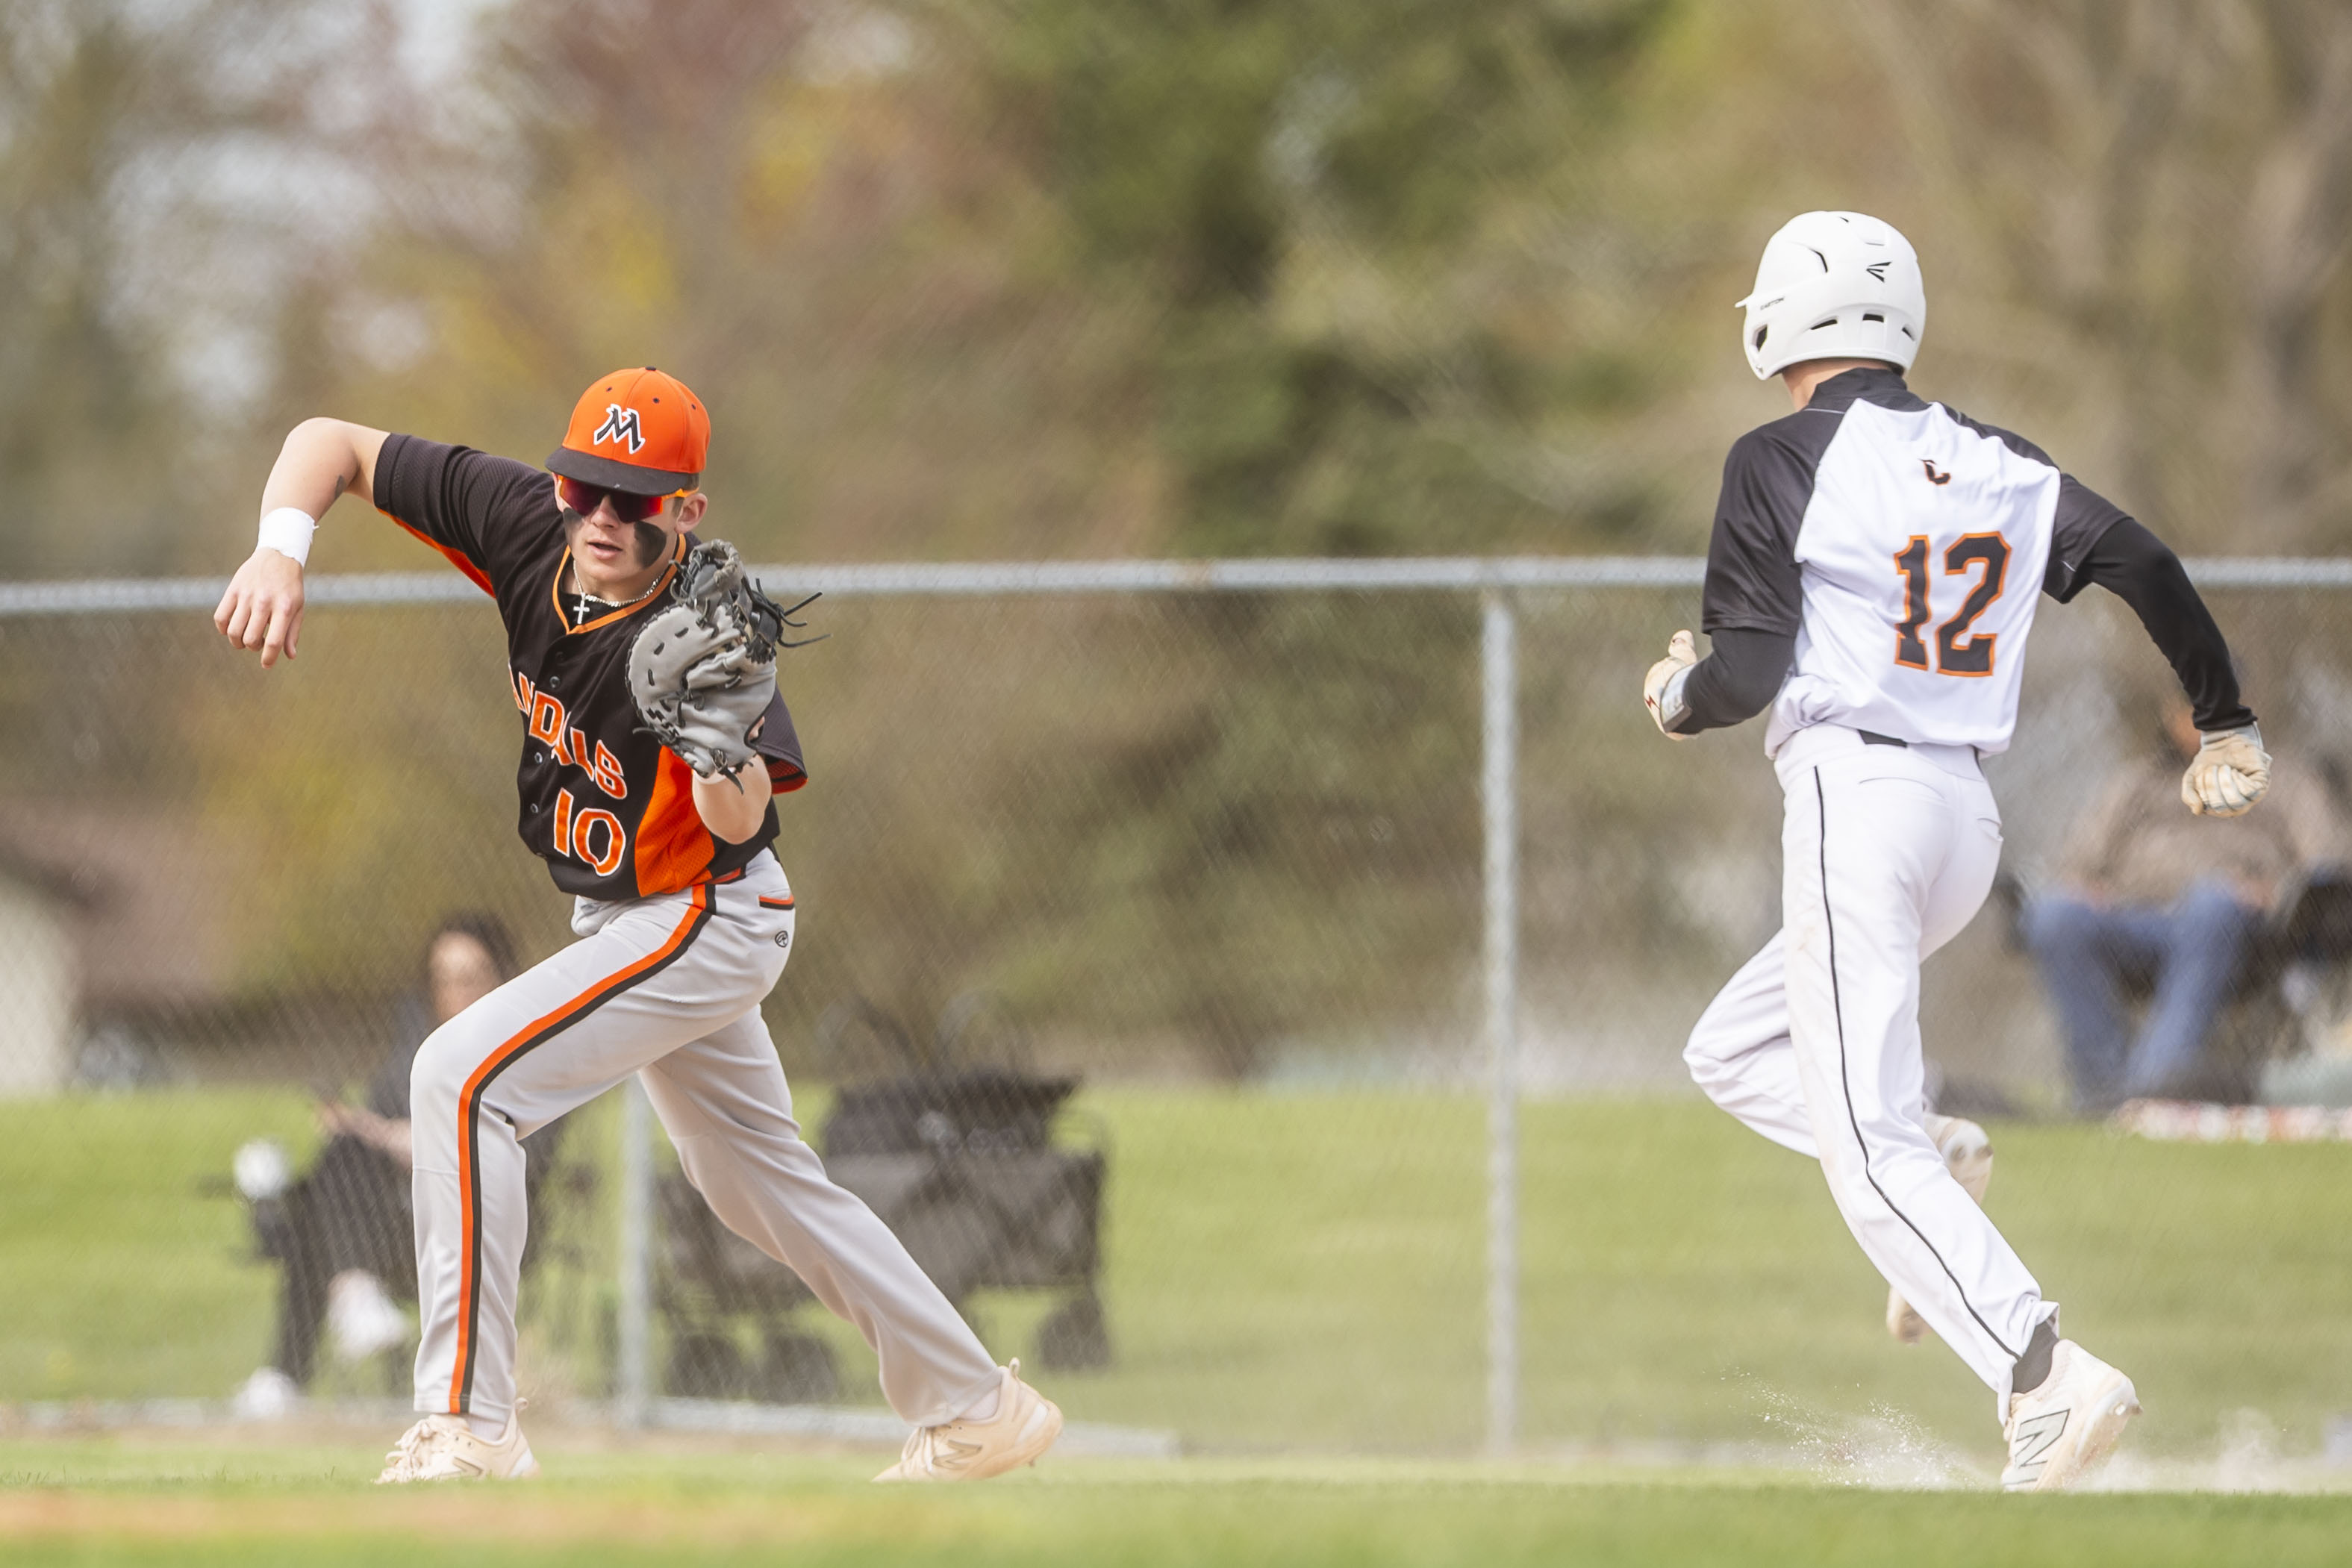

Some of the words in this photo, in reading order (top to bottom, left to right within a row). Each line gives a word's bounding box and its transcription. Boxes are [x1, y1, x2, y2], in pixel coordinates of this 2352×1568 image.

[593, 404, 646, 455] M
[1893, 531, 2012, 677] 12
[554, 787, 626, 876] 10
